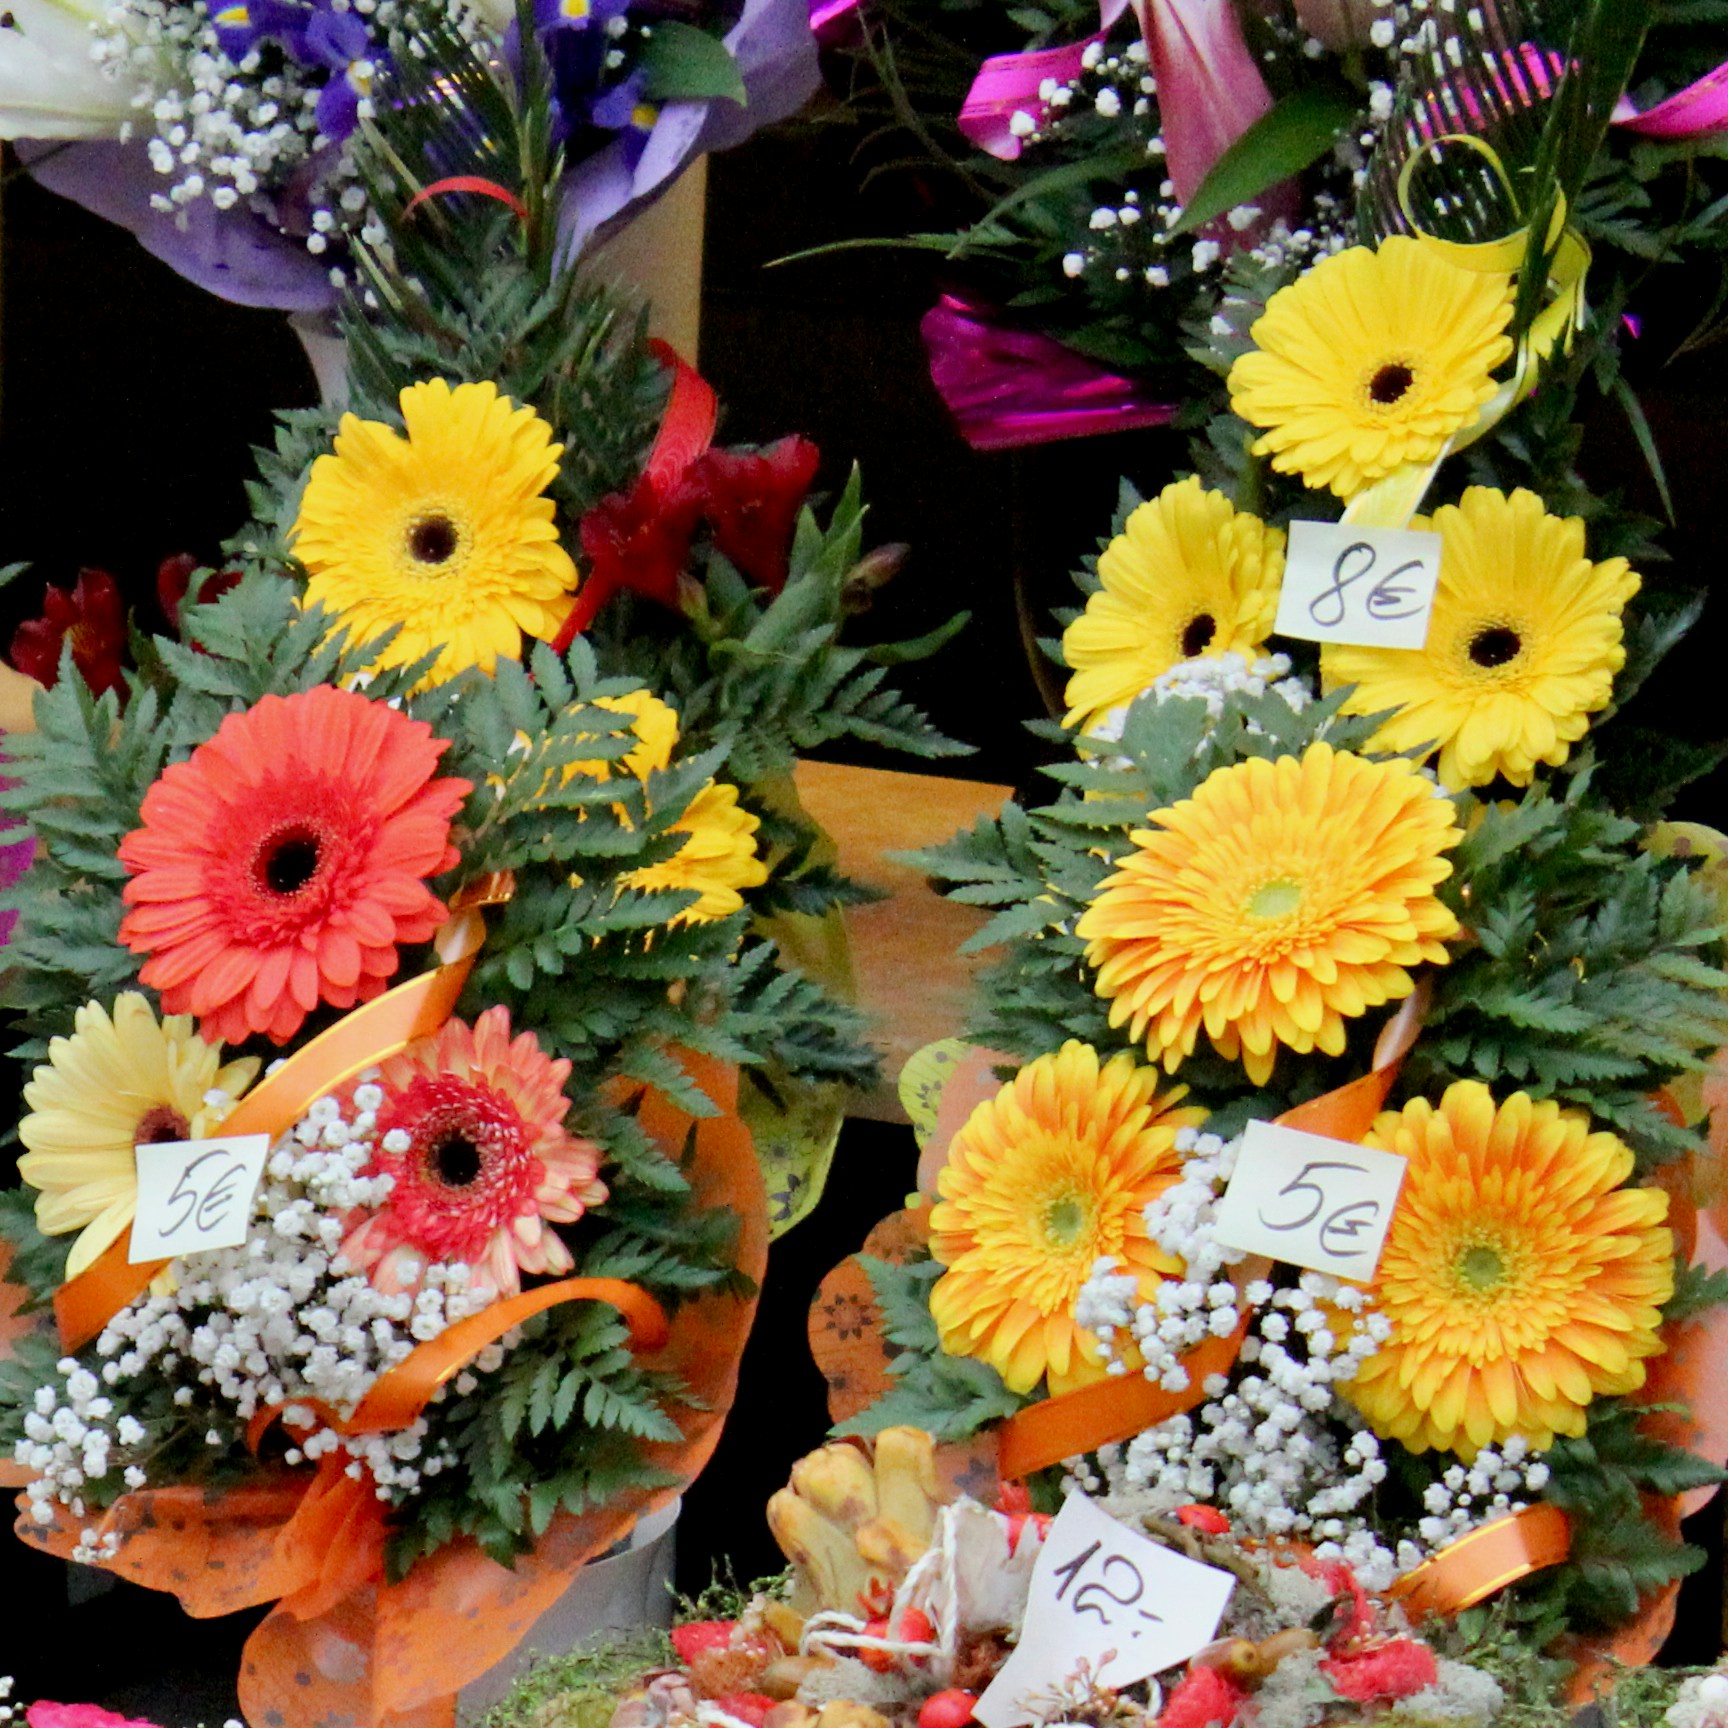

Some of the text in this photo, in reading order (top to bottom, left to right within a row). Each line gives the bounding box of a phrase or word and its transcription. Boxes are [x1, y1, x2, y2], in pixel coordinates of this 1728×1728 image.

[1308, 541, 1426, 628] 8€
[158, 1148, 247, 1238] 5€
[1257, 1161, 1380, 1258] 5€
